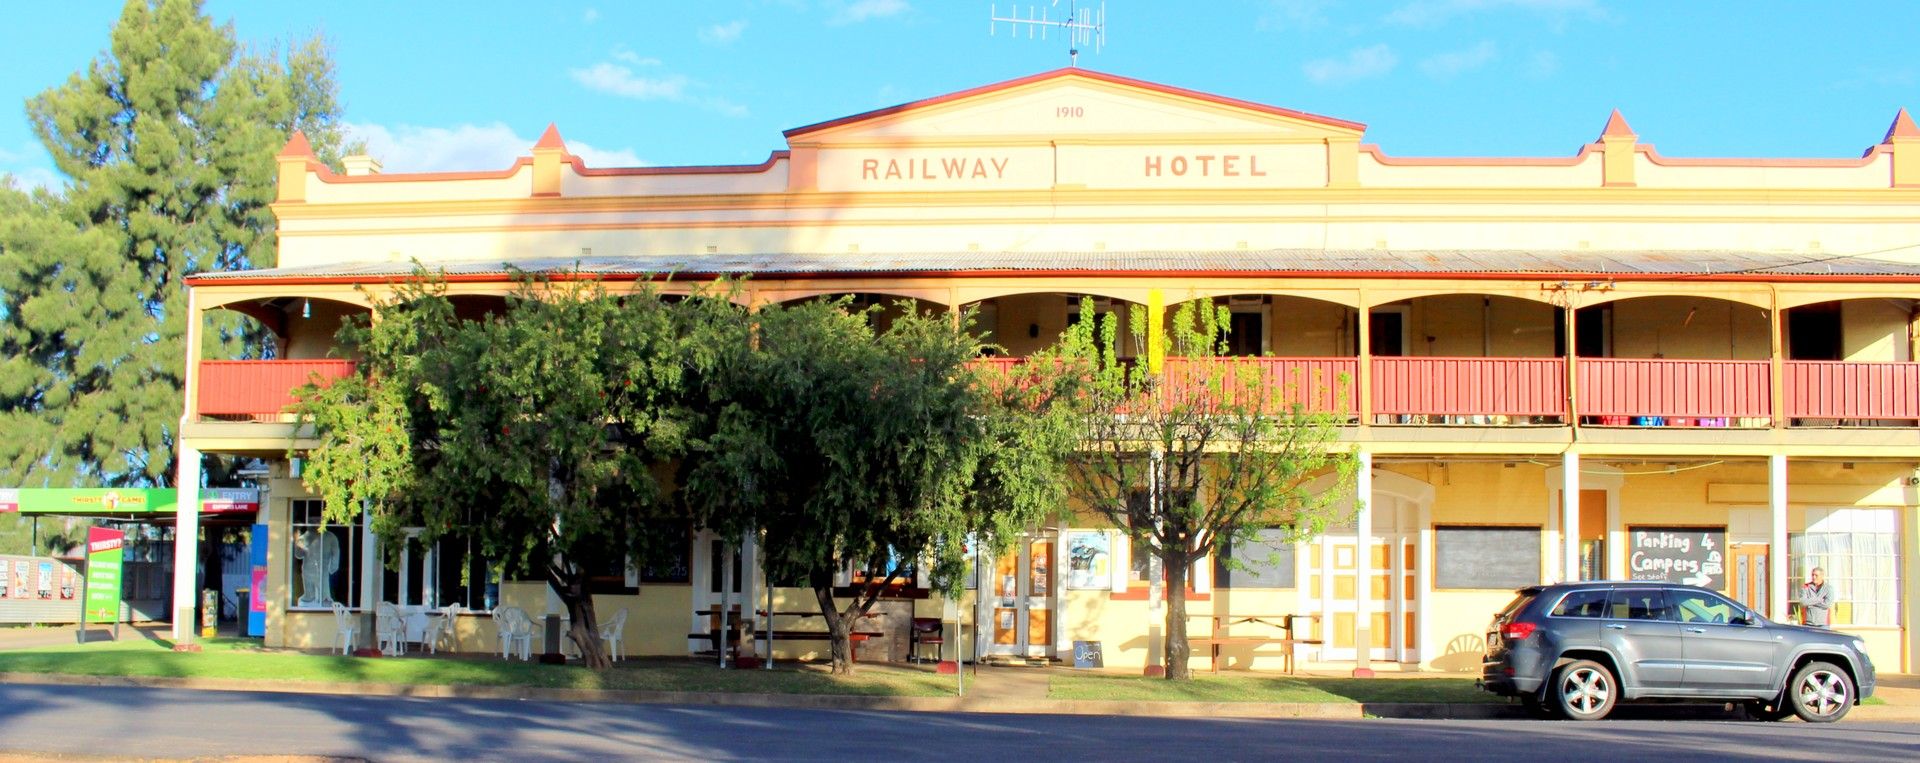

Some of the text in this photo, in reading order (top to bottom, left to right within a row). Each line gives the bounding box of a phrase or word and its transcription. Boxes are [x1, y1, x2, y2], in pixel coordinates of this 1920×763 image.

[1056, 106, 1084, 118] 1910
[862, 155, 1267, 180] RAILWAY HOTEL
[222, 491, 251, 500] ENTRY
[1635, 531, 1715, 553] Parking 4
[1630, 550, 1699, 573] Campers
[1075, 645, 1100, 663] Open
